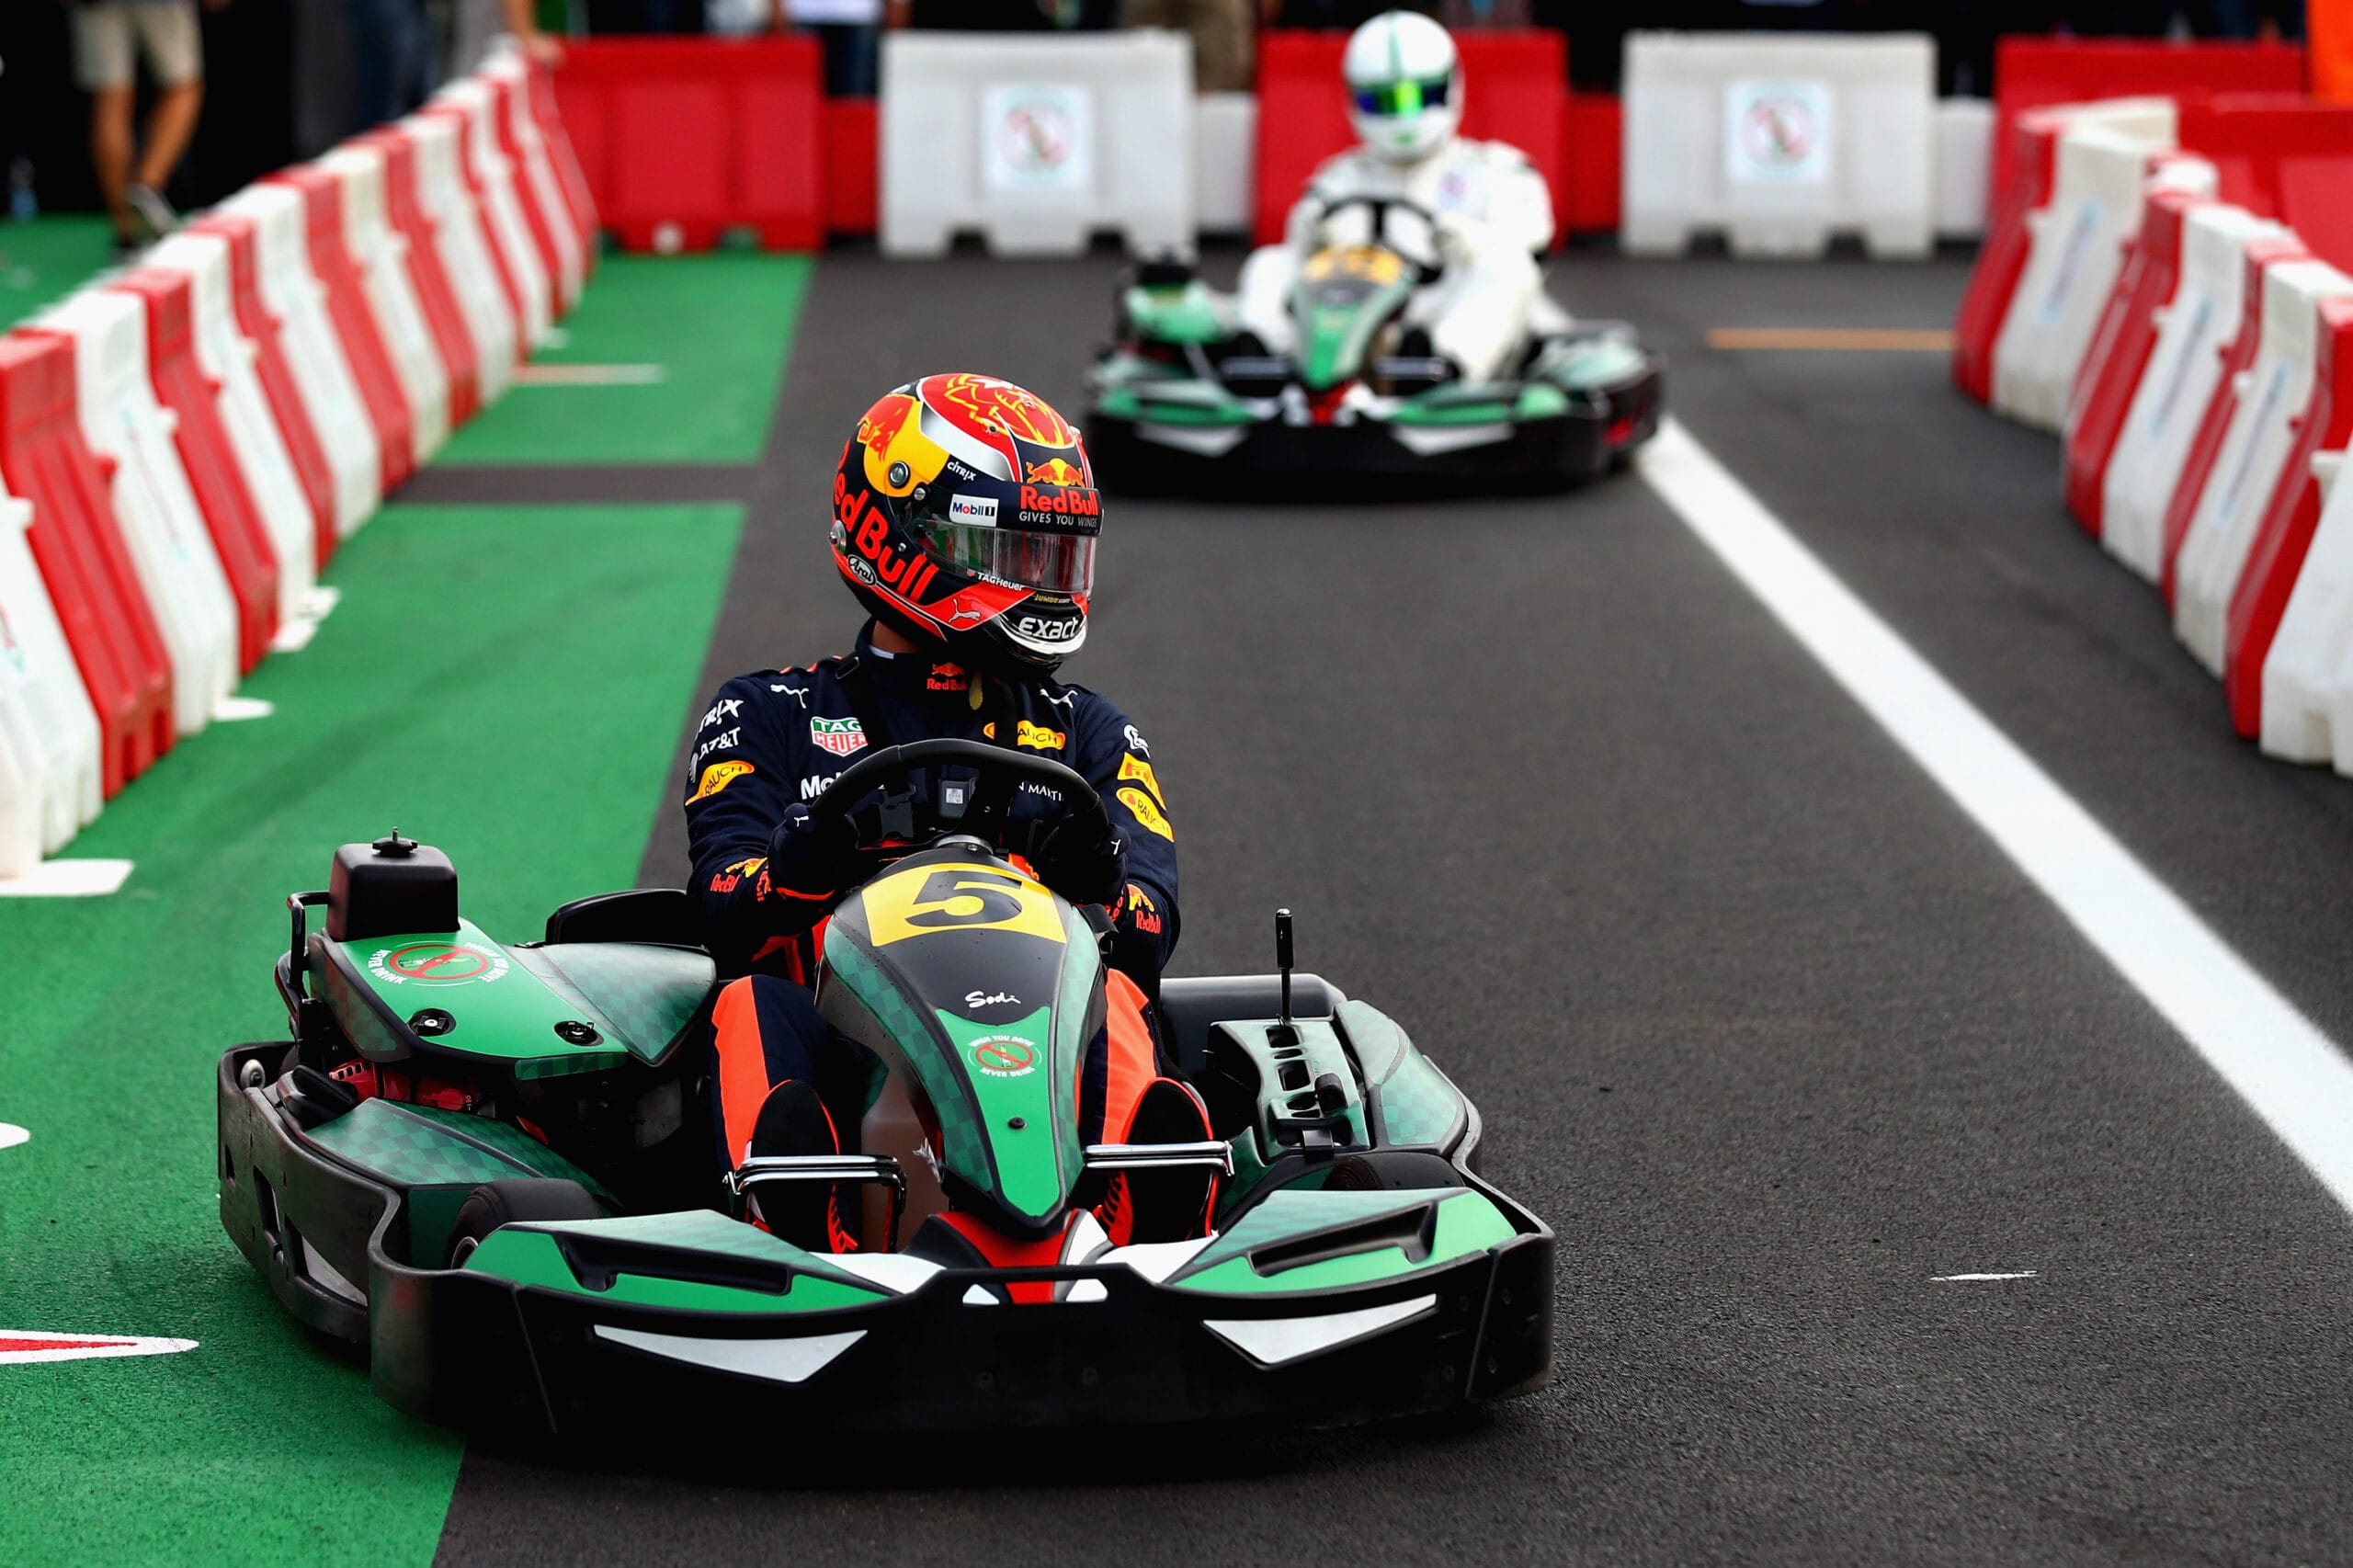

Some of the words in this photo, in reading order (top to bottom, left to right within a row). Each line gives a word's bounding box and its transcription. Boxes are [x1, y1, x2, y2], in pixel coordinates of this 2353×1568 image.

[952, 502, 984, 516] Mobil
[1020, 485, 1068, 513] Red
[1068, 490, 1098, 516] Bull
[1019, 511, 1051, 524] GIVES
[1056, 515, 1074, 526] YOU
[1078, 517, 1097, 528] WINGS
[855, 506, 940, 602] Bull
[849, 560, 872, 582] Arai
[814, 720, 862, 733] TAG
[699, 727, 741, 760] AT&T
[816, 733, 867, 752] HEUER
[704, 767, 743, 796] RAUCH
[905, 871, 1022, 927] 5
[368, 949, 392, 968] NEVER
[370, 968, 407, 983] DRINK
